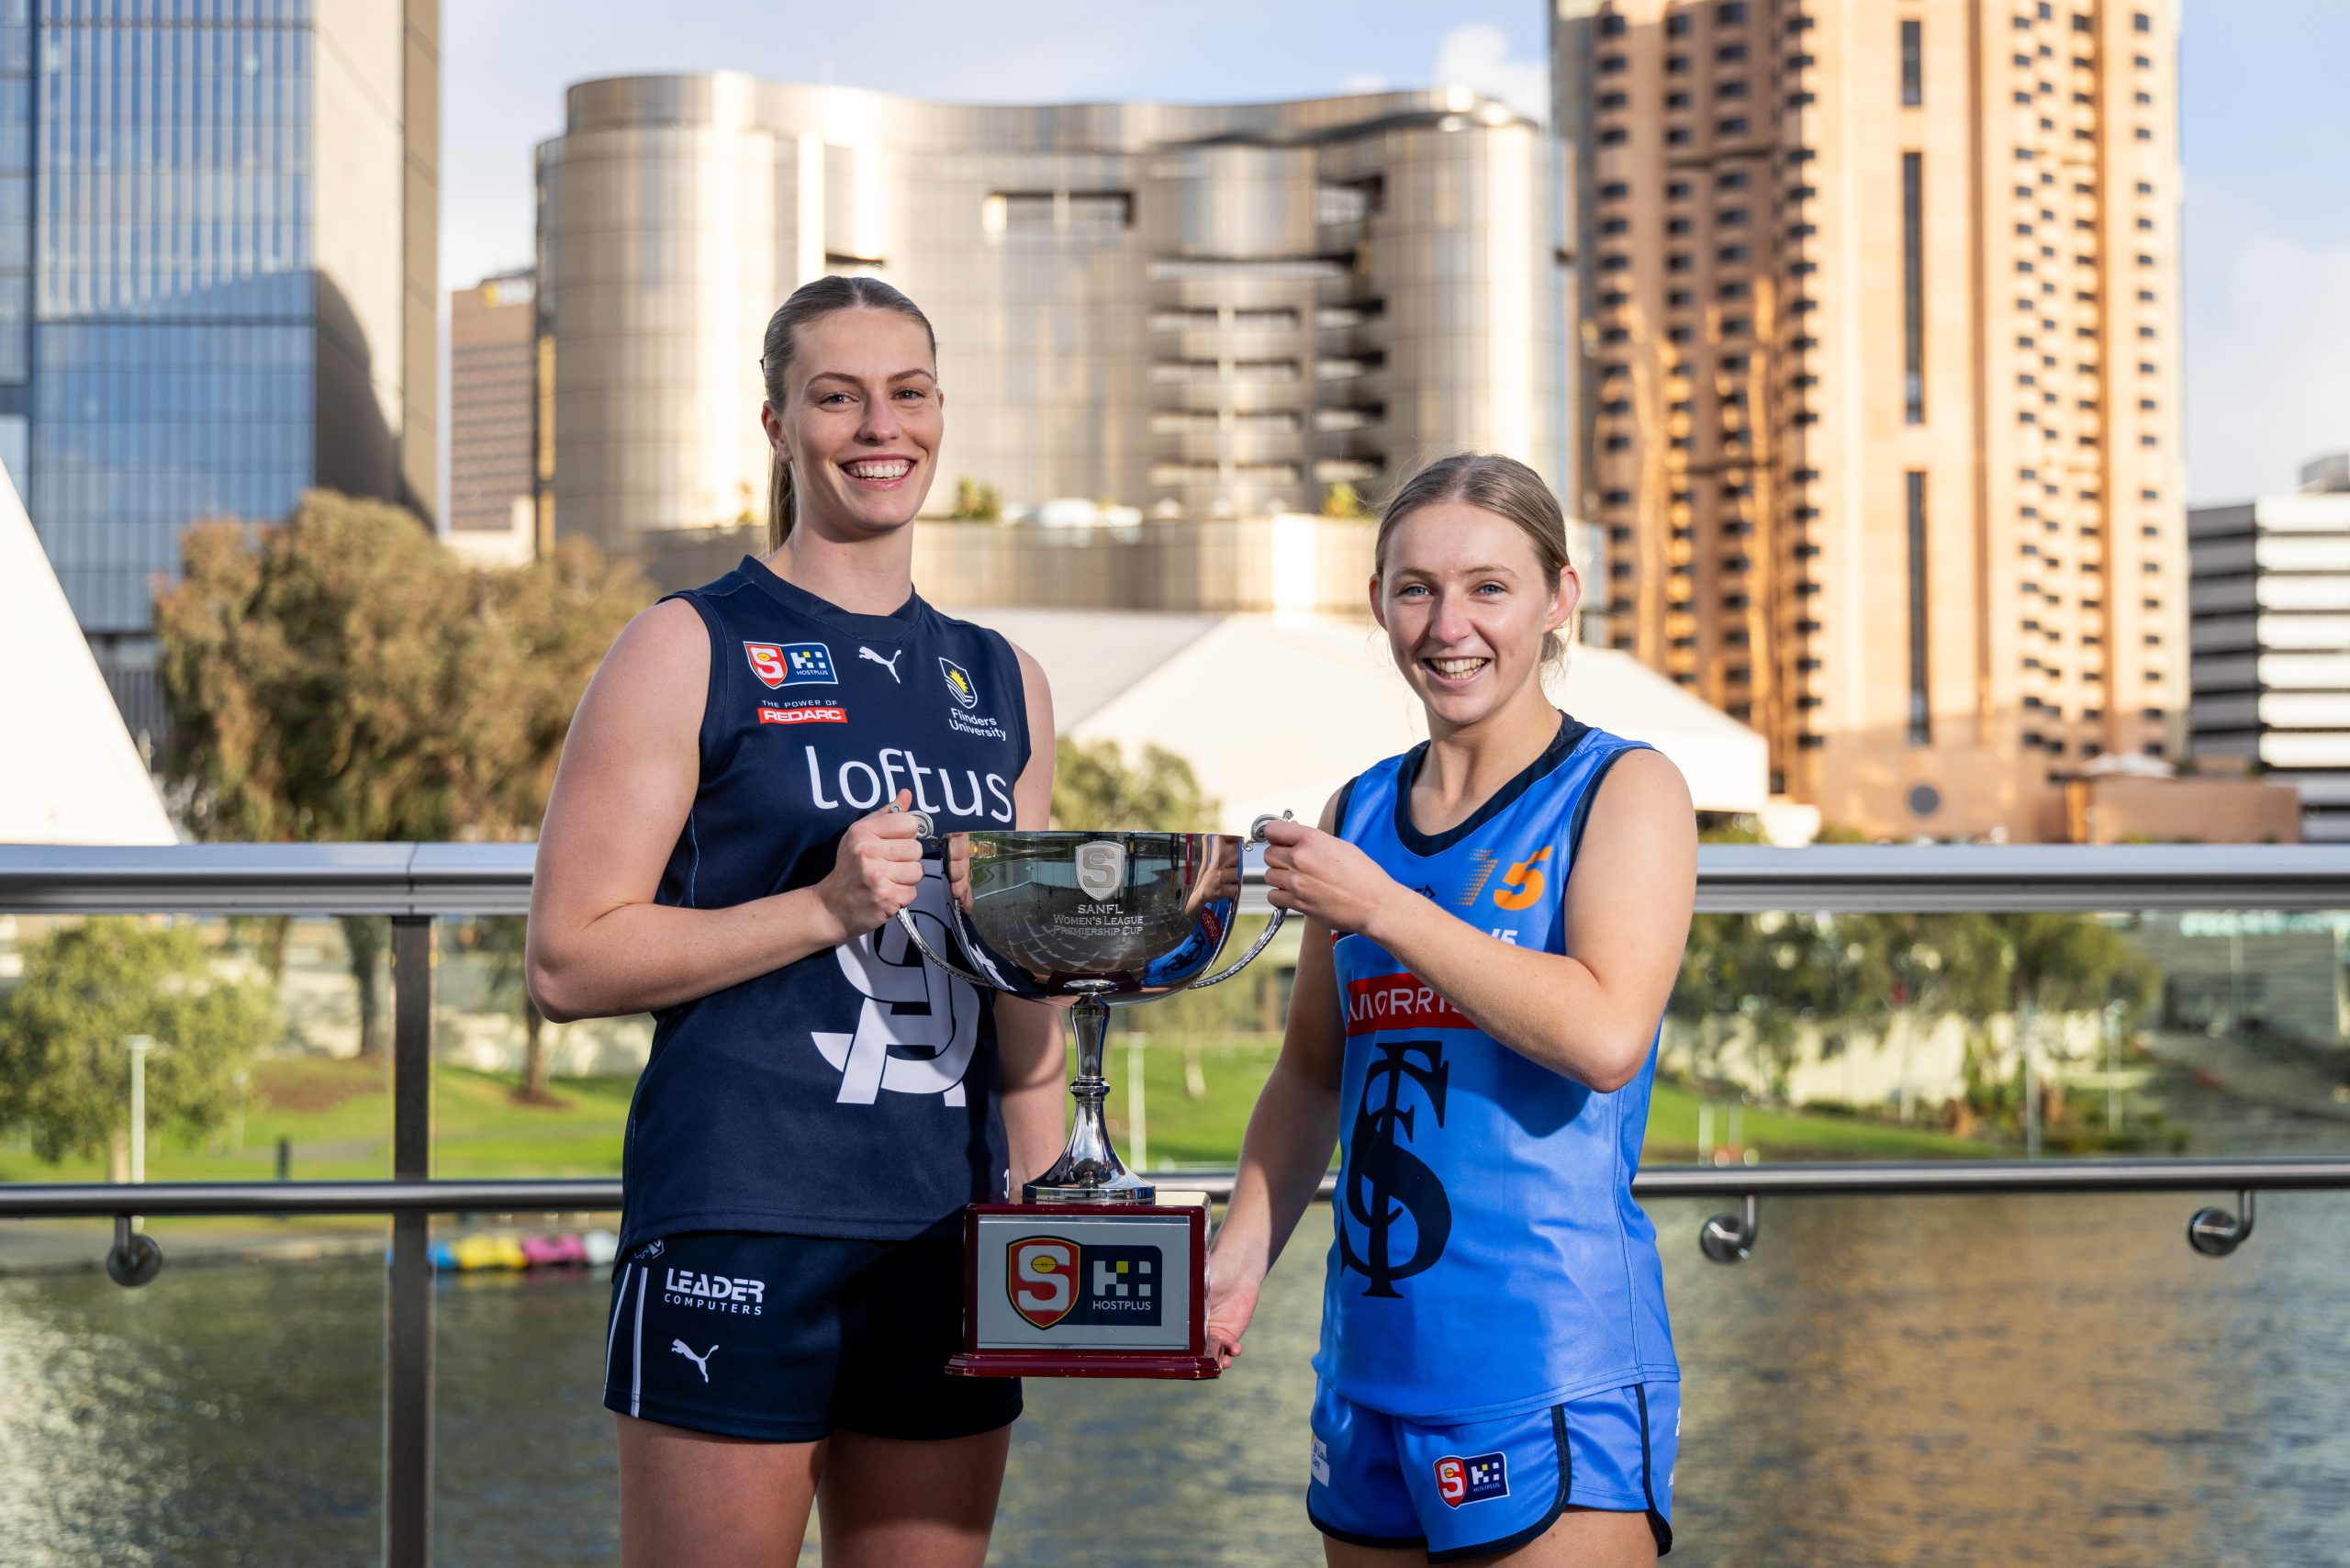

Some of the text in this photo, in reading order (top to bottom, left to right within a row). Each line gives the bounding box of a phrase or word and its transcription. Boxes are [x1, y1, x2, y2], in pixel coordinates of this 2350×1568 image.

[762, 700, 779, 708] THE
[784, 700, 822, 708] POWER
[763, 710, 842, 722] REDARC
[950, 707, 997, 726] Flinders
[948, 718, 1006, 741] University
[1078, 903, 1125, 914] SANFL
[1018, 1245, 1070, 1311] S
[666, 1268, 766, 1304] LEADER
[664, 1293, 762, 1316] COMPUTERS
[1092, 1300, 1151, 1311] HOSTPLUS
[1473, 1483, 1501, 1493] HOSTPLUS
